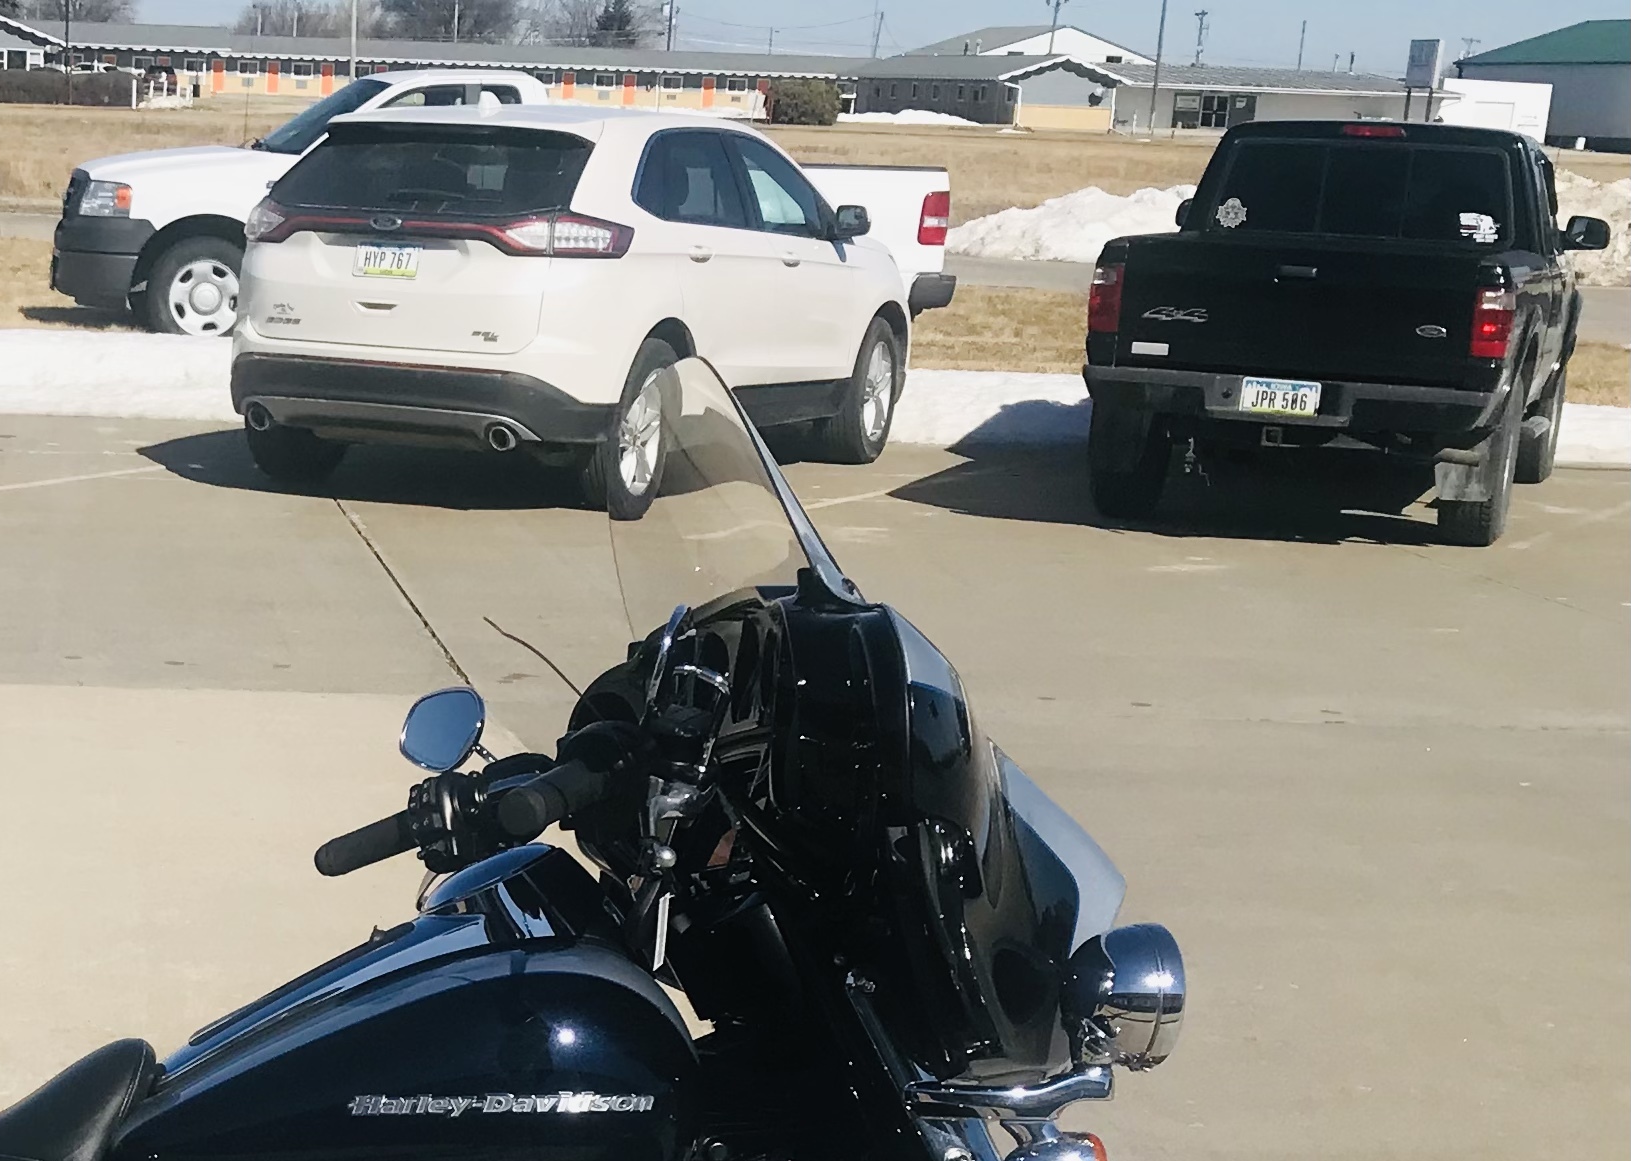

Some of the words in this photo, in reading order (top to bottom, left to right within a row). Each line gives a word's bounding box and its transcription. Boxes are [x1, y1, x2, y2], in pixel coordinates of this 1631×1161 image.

[364, 251, 386, 268] HYP
[390, 252, 411, 269] 767
[1251, 390, 1277, 408] JPR
[1281, 392, 1307, 411] 506
[348, 1091, 655, 1118] Harley-Davidson
